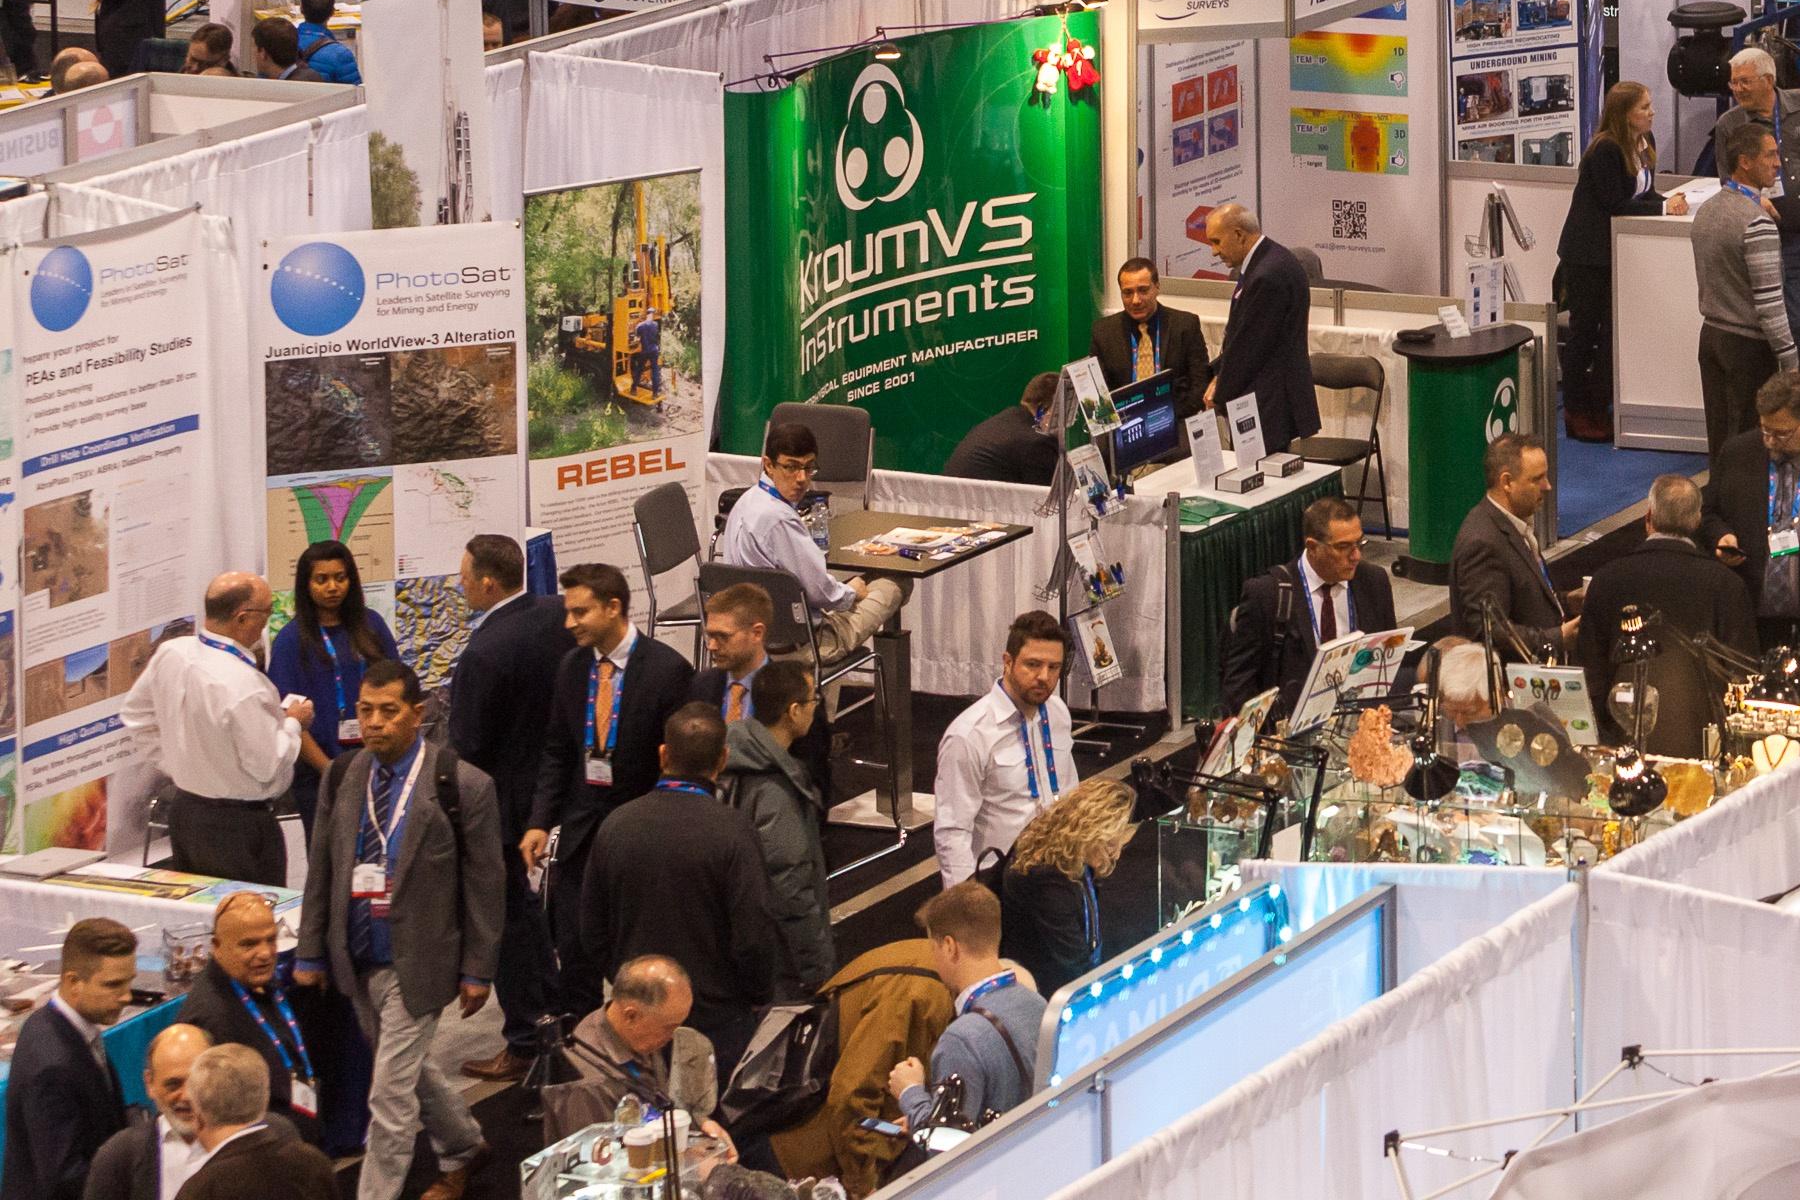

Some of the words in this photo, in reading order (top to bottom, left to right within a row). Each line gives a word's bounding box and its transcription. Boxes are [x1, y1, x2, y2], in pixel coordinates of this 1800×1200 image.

[1295, 54, 1313, 65] TEM
[1393, 46, 1406, 57] 1D
[1469, 55, 1528, 71] UNDERGROUND
[1529, 50, 1559, 63] MINING
[1295, 123, 1313, 134] TEM
[1394, 129, 1407, 141] 3D
[100, 253, 192, 285] PhotoSat
[375, 266, 513, 291] PhotoSat
[376, 295, 414, 307] Leaders
[414, 293, 424, 303] in
[425, 291, 463, 303] Satellite
[464, 288, 511, 302] Surveying
[376, 306, 390, 317] for
[391, 304, 426, 317] Mining
[425, 303, 446, 314] and
[446, 301, 480, 314] Energy
[800, 273, 1038, 376] Instruments
[264, 338, 343, 361] Juanicipio
[345, 332, 441, 354] WorldView-3
[443, 326, 516, 345] Alteration
[26, 370, 56, 388] PEAs
[59, 363, 83, 379] and
[85, 349, 147, 372] Feasibility
[149, 335, 193, 357] Studies
[841, 354, 907, 389] EQUIPMENT
[911, 331, 1039, 364] MANUFACTURER
[846, 383, 881, 404] SINCE
[884, 370, 916, 392] 2001
[556, 446, 687, 492] REBEL
